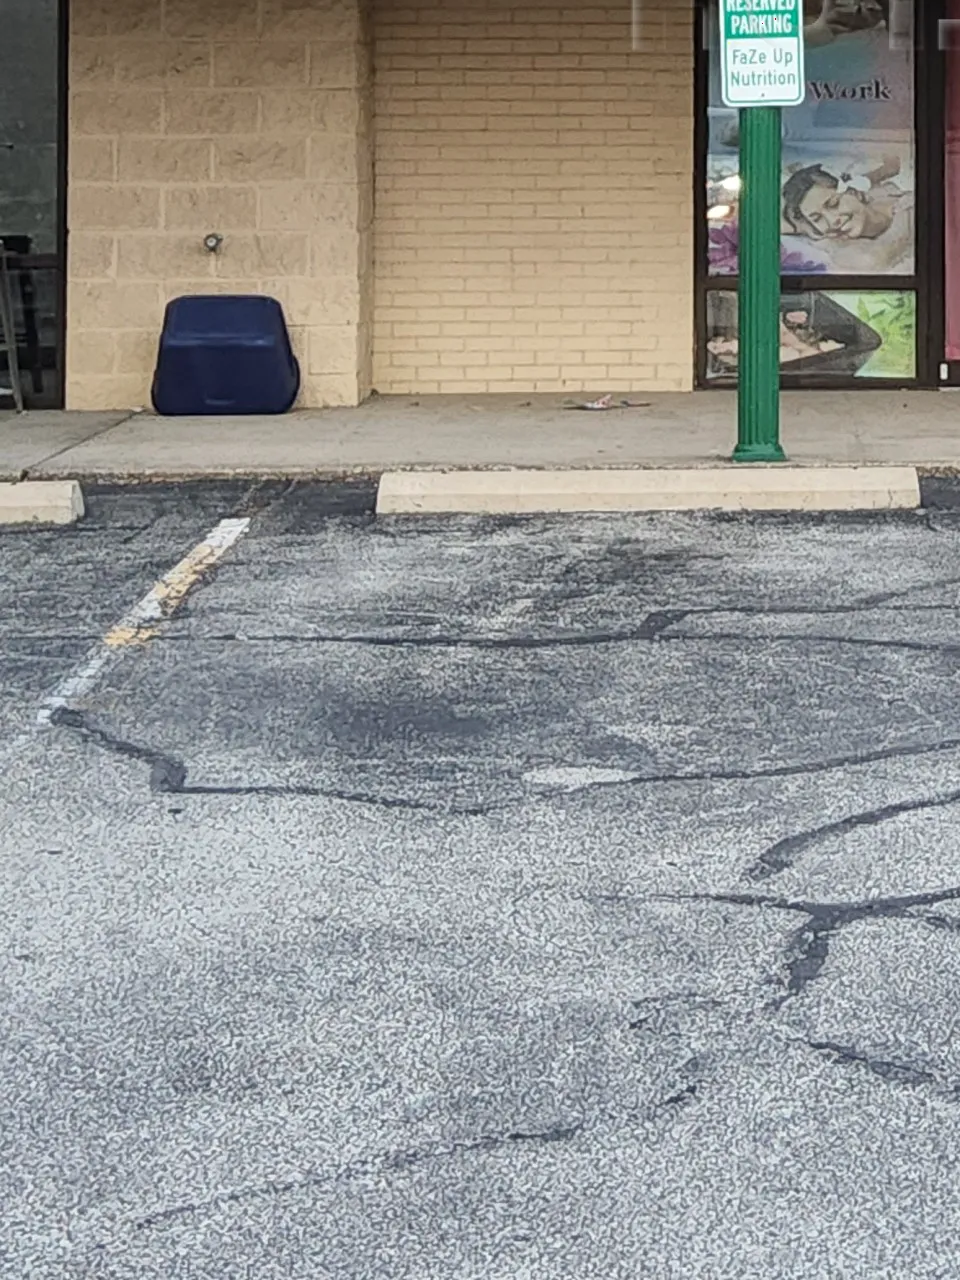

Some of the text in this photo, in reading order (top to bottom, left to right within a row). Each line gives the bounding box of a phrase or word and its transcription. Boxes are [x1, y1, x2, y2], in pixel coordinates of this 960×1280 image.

[731, 14, 792, 35] PARKING
[732, 48, 794, 66] FaZe Up
[730, 70, 796, 87] Nutrition
[810, 80, 892, 101] Work
